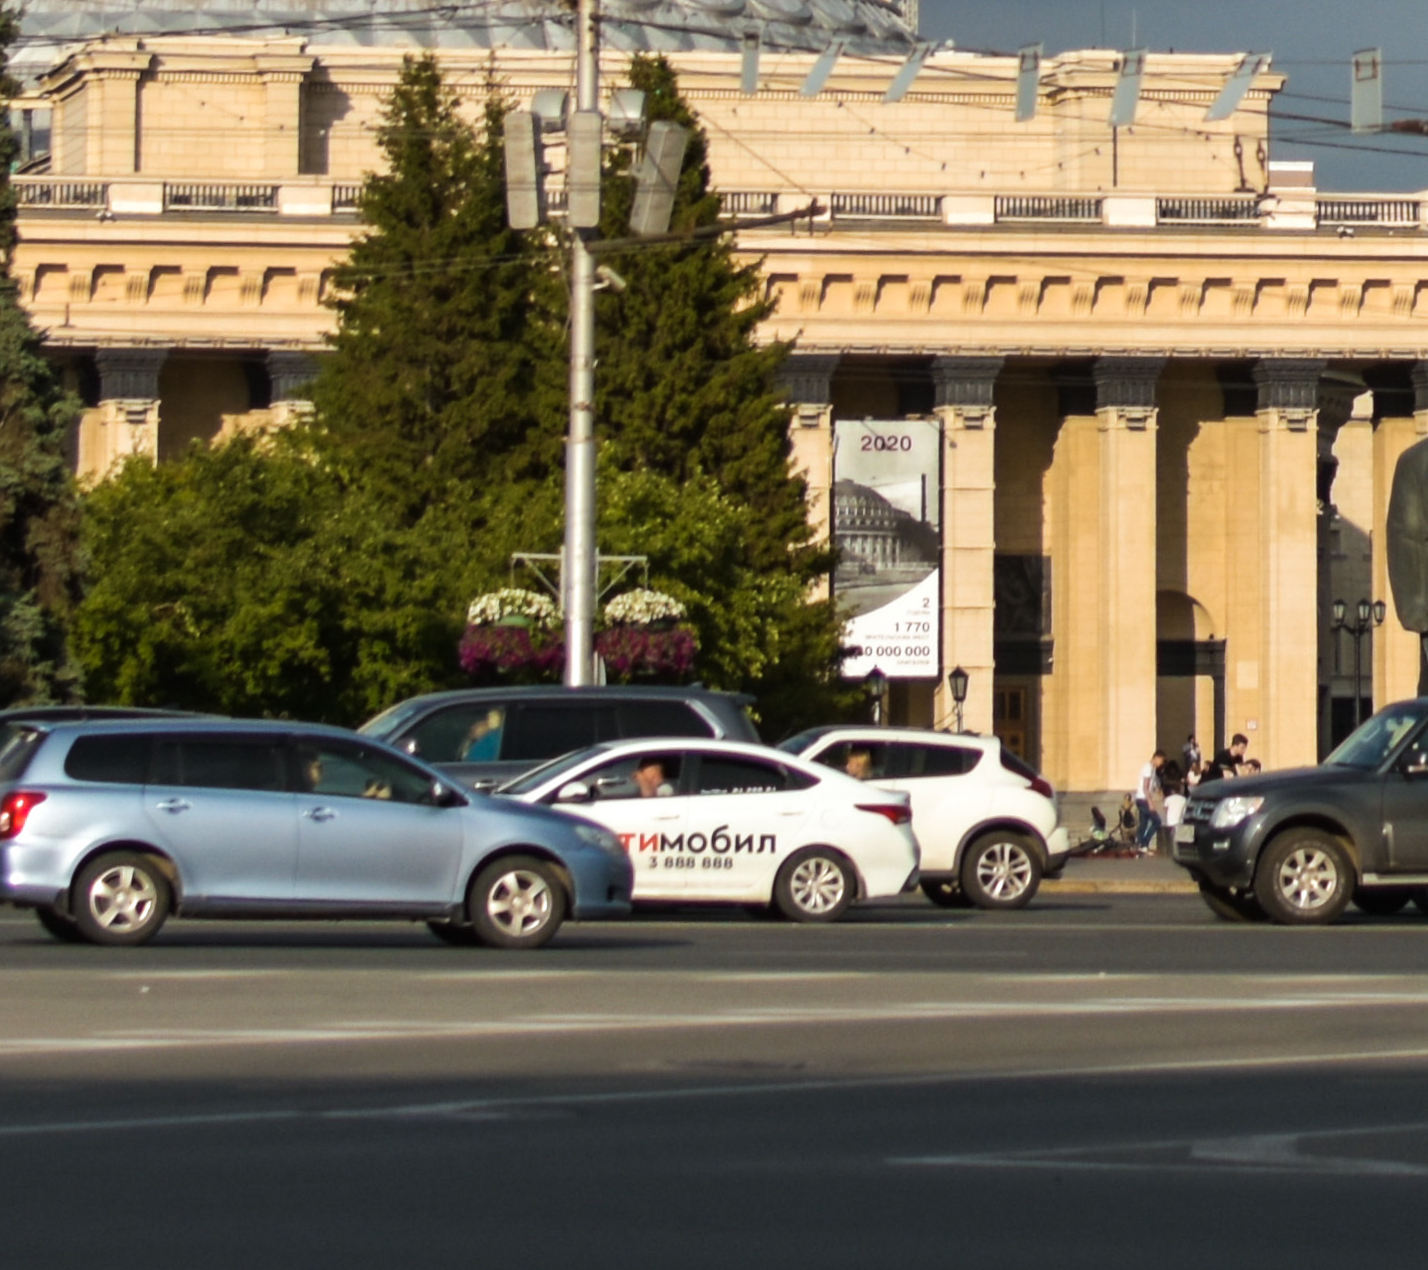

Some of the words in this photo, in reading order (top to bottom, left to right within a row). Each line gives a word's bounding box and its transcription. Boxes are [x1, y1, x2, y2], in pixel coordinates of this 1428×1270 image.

[860, 435, 912, 451] 2020
[922, 597, 930, 608] 2
[895, 622, 899, 632] 1
[905, 622, 930, 632] 770
[876, 646, 901, 657] 000
[905, 646, 930, 657] 000
[649, 856, 658, 869] 3
[664, 856, 696, 869] 888
[702, 856, 733, 869] 888
